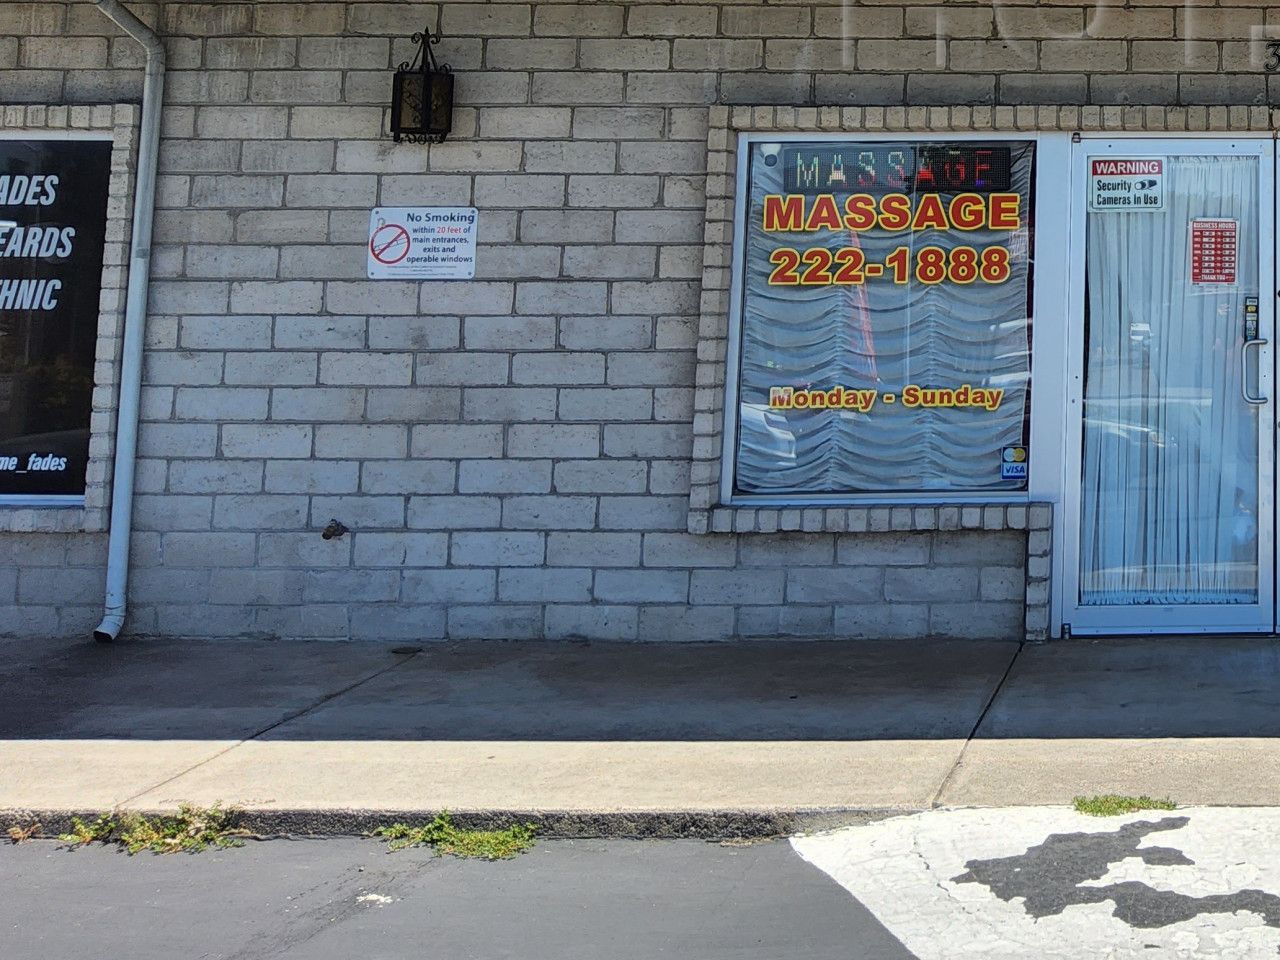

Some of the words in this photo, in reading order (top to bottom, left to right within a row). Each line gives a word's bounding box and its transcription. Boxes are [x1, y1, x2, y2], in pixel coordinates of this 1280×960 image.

[797, 151, 993, 187] MASSAGE
[1096, 161, 1159, 174] WARNING
[1096, 180, 1132, 193] Security
[1096, 194, 1132, 205] Cameras
[1134, 194, 1141, 205] In
[1144, 194, 1158, 205] Use
[406, 213, 422, 222] No
[425, 212, 475, 224] Smoking
[763, 193, 1021, 231] MASSAGE
[432, 236, 469, 244] entrances,
[406, 256, 439, 264] operable
[768, 246, 1011, 286] 222-1888
[0, 279, 62, 311] HNIC
[770, 386, 877, 412] Monday
[902, 384, 1004, 412] Sunday
[1005, 465, 1025, 474] VISA
